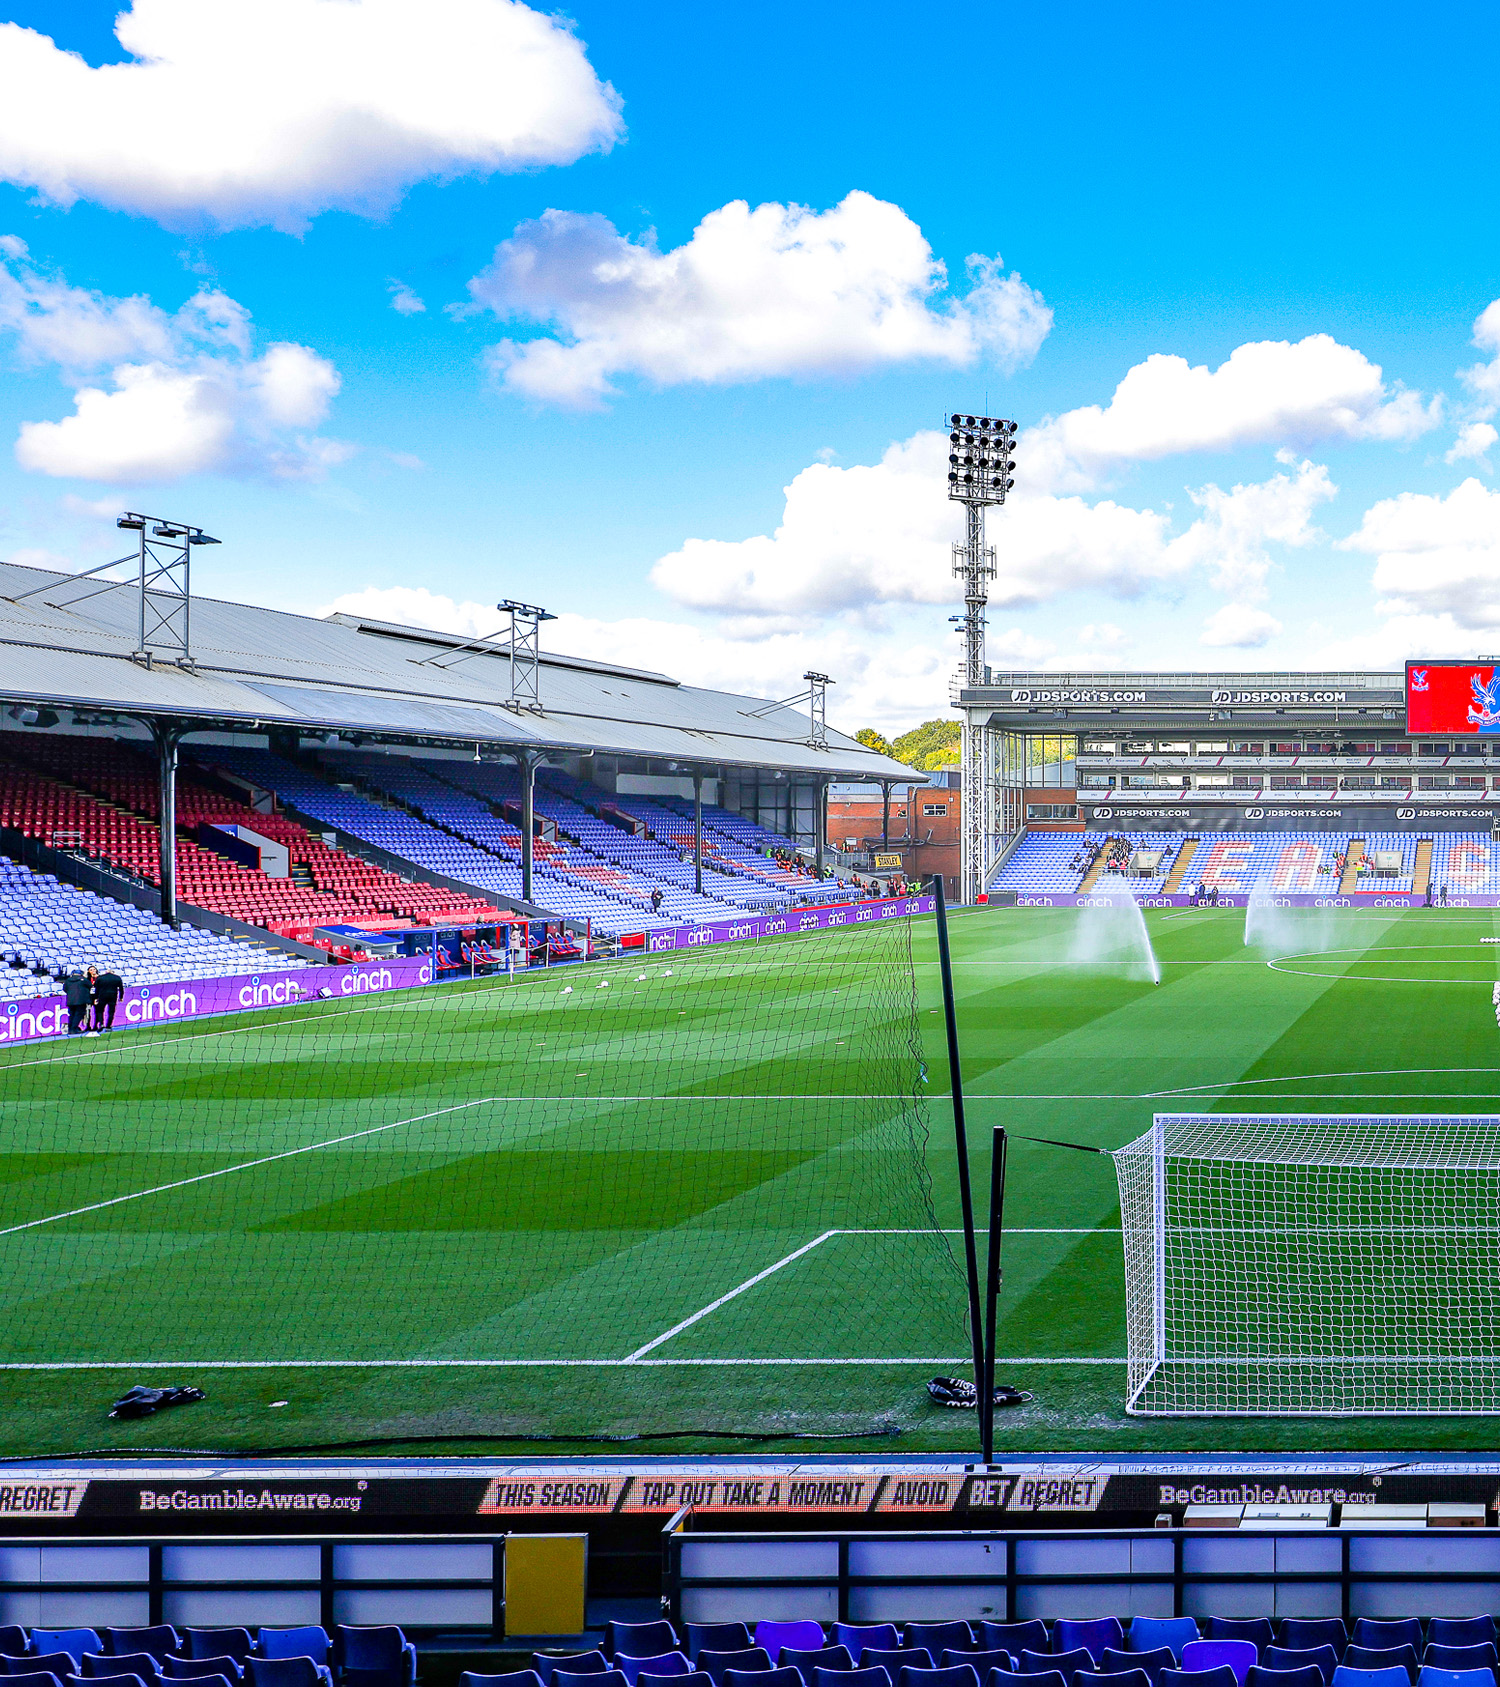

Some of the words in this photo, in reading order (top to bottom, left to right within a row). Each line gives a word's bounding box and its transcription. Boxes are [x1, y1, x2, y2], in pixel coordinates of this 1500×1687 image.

[1032, 691, 1146, 702] JDSPORTS.COM
[1233, 691, 1346, 702] JDSPORTS.COM
[1114, 808, 1190, 818] JDSPORTS.COM
[1265, 808, 1341, 818] JDSPORTS.COM
[1417, 808, 1493, 818] JDSPORTS.COM
[878, 856, 898, 866] STANLEY
[1016, 894, 1053, 908] cinch
[1136, 894, 1172, 908] cinch
[1314, 894, 1350, 908] cinch
[1374, 894, 1410, 908] cinch
[649, 931, 674, 950] inch
[687, 926, 713, 946] cinch
[729, 920, 751, 939] cinch
[765, 917, 787, 935] cinch
[125, 988, 196, 1022] cinch
[238, 976, 300, 1007] cinch
[340, 965, 392, 995] cinch
[498, 1483, 534, 1506] THIS
[540, 1483, 610, 1506] SEASON
[642, 1482, 675, 1506] TAP
[680, 1482, 714, 1505] OUT
[722, 1482, 763, 1505] TAKE
[768, 1482, 780, 1504] A
[789, 1482, 866, 1505] MOMENT
[892, 1482, 950, 1505] AVOID
[968, 1480, 1012, 1506] BET
[1020, 1481, 1097, 1506] REGRET
